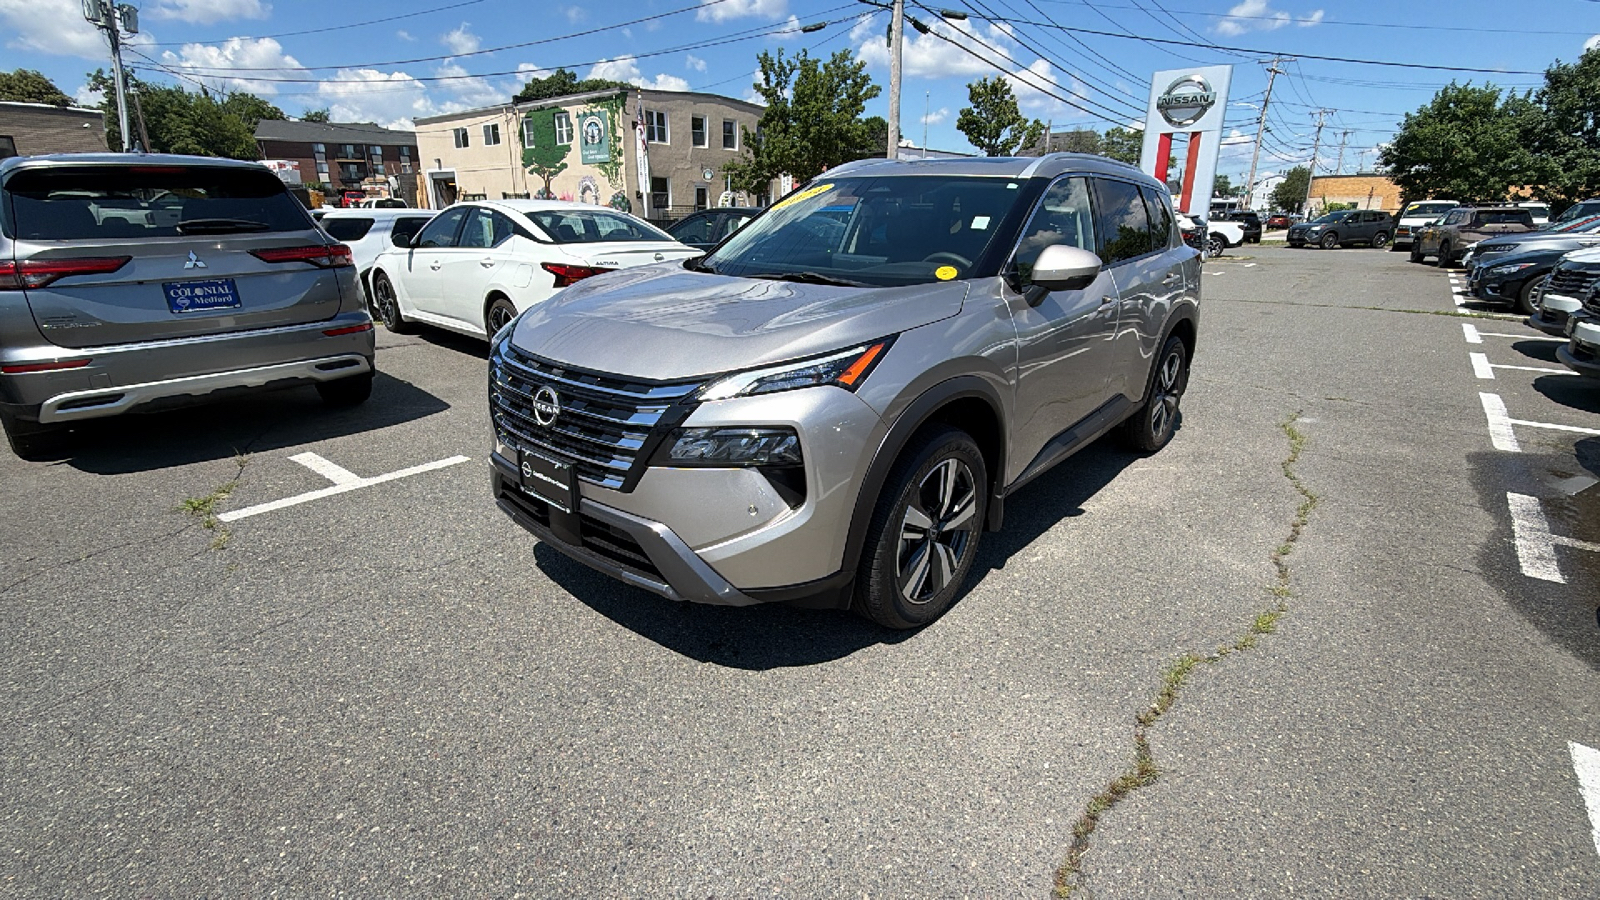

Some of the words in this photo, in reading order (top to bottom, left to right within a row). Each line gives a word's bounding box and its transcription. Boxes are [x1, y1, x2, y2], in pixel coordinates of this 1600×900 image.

[1161, 95, 1210, 105] NISSAN
[170, 285, 233, 298] COLONIAL
[194, 295, 233, 304] Medford
